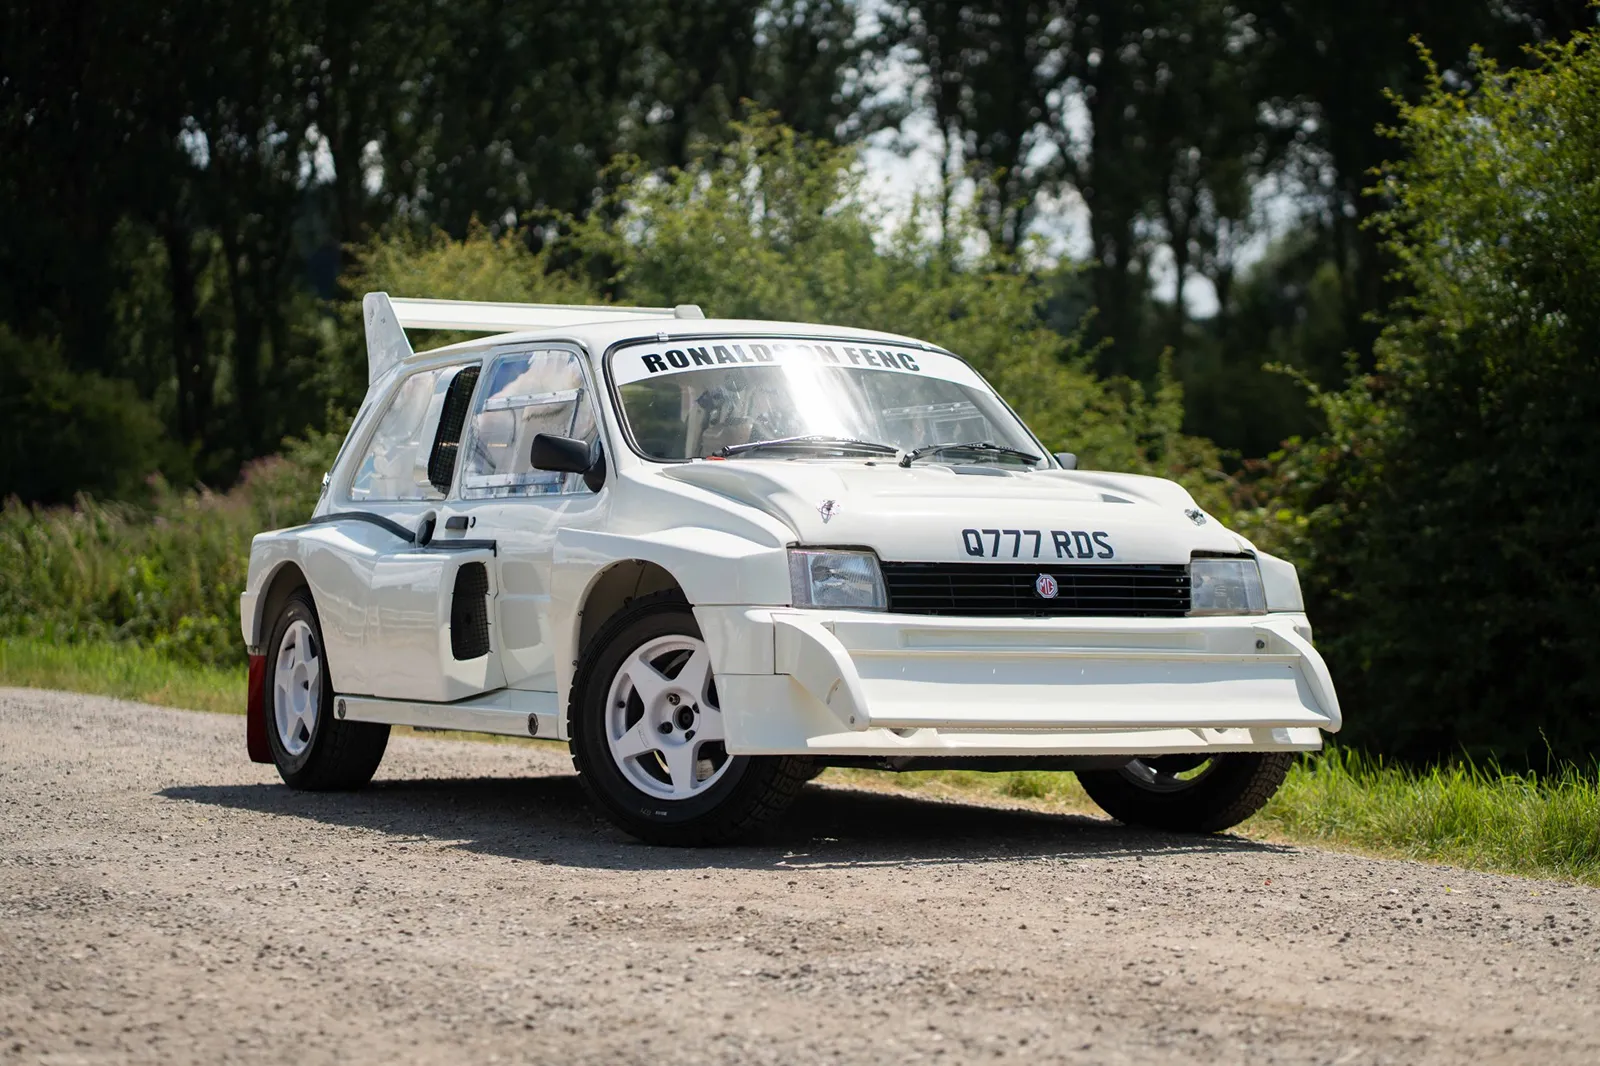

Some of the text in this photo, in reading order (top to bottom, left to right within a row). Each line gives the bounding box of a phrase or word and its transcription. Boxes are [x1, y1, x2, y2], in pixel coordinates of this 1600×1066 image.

[641, 346, 920, 373] RONALDN FENC
[962, 529, 1114, 559] Q777 RDS
[1039, 578, 1054, 596] MG
